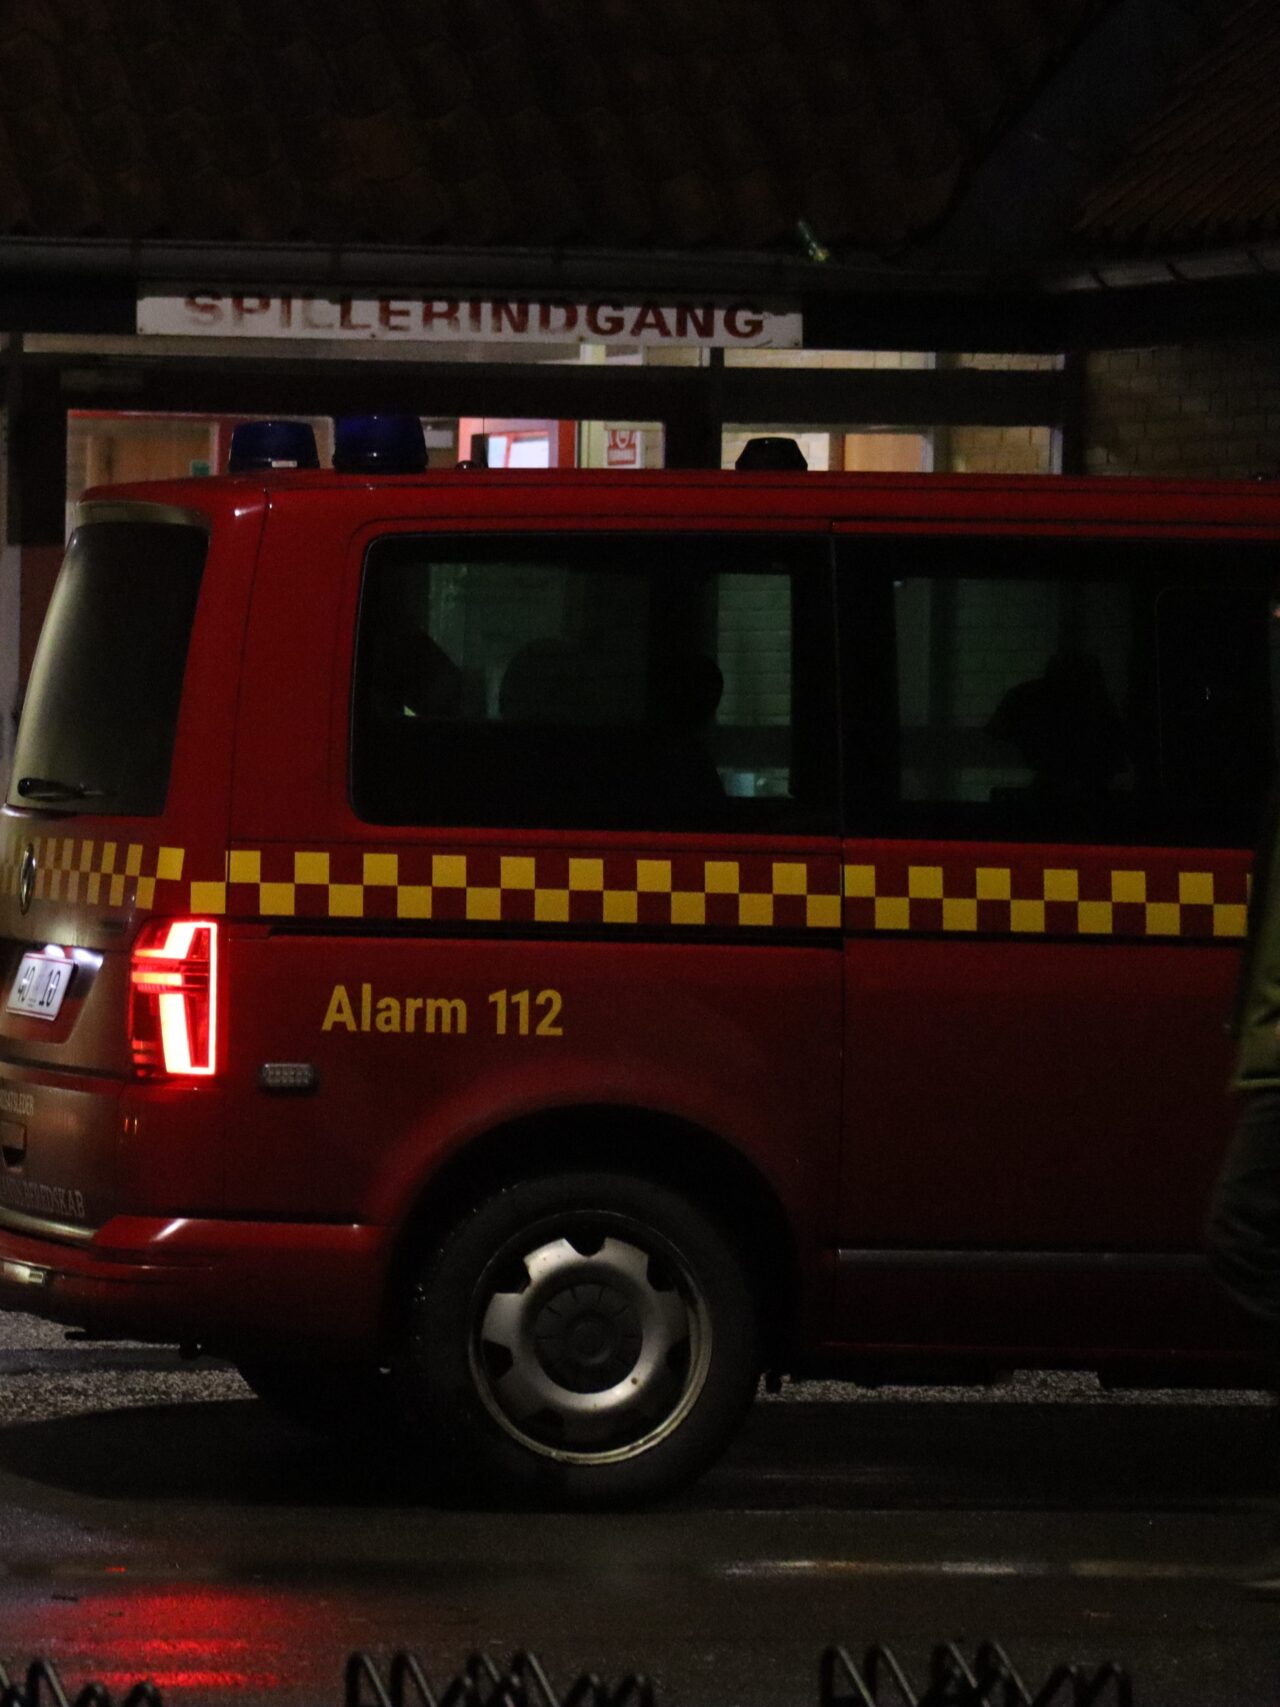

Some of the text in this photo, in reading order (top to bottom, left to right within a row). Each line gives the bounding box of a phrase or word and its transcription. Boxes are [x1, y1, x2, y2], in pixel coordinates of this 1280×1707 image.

[183, 291, 765, 338] SPILLERINDGANG
[321, 983, 563, 1036] Alarm 112
